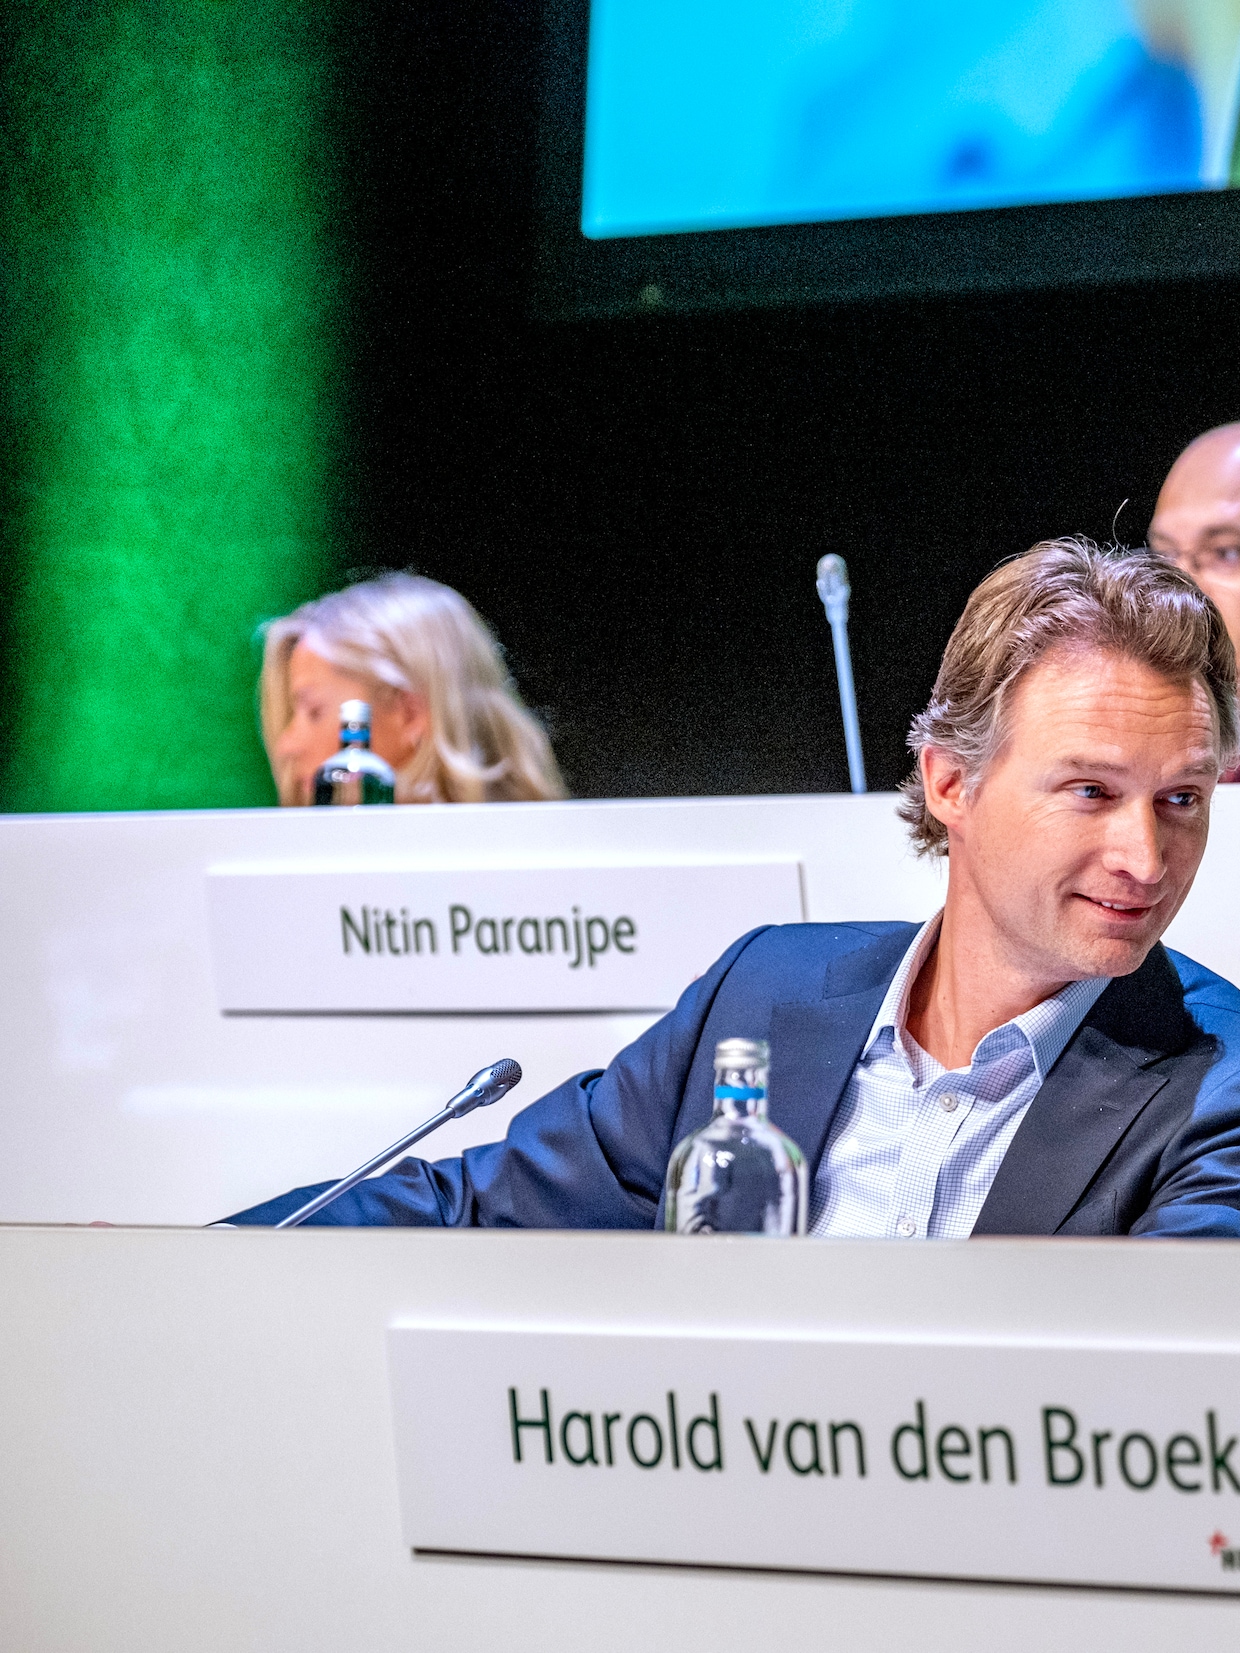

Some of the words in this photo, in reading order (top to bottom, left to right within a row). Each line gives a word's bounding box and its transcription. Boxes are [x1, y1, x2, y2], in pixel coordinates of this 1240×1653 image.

[339, 905, 438, 956] Nitin
[448, 903, 638, 969] Paranjpe
[507, 1386, 725, 1473] Harold
[743, 1417, 869, 1479] van
[889, 1399, 1019, 1485] den
